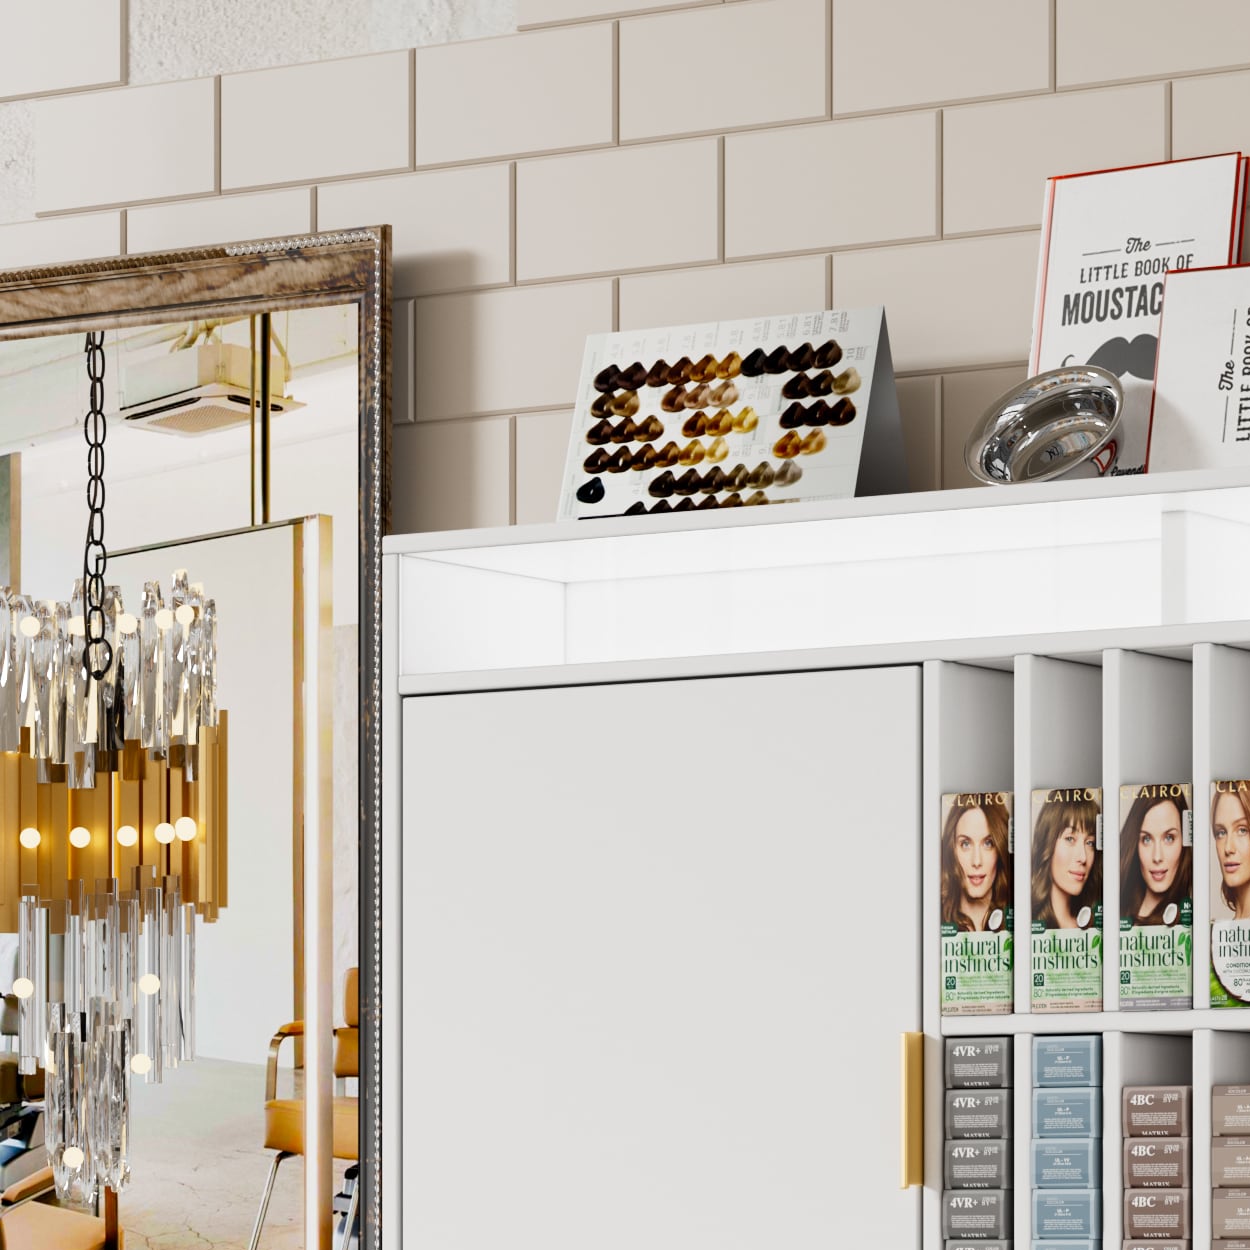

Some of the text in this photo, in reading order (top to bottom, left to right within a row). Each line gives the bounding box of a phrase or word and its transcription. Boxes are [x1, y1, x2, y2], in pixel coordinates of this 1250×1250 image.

[1125, 237, 1151, 254] The
[1080, 254, 1193, 284] LITTLE BOOK OF
[1061, 282, 1164, 326] MOUSTAC
[1219, 360, 1235, 390] The
[945, 935, 1000, 956] natural
[1033, 932, 1088, 953] natural
[1120, 929, 1174, 951] natural
[945, 956, 1010, 973] instincts
[1033, 952, 1098, 970] instincts
[1120, 950, 1184, 967] instincts
[946, 977, 956, 985] 20
[1034, 974, 1044, 982] 20
[953, 1045, 981, 1057] 4VR+
[953, 1097, 981, 1108] 4VR+
[1130, 1094, 1155, 1106] 4BC
[952, 1147, 980, 1158] 4VR+
[1131, 1144, 1156, 1157] 4BC
[950, 1197, 978, 1208] 4VR+
[1131, 1195, 1156, 1208] 4BC
